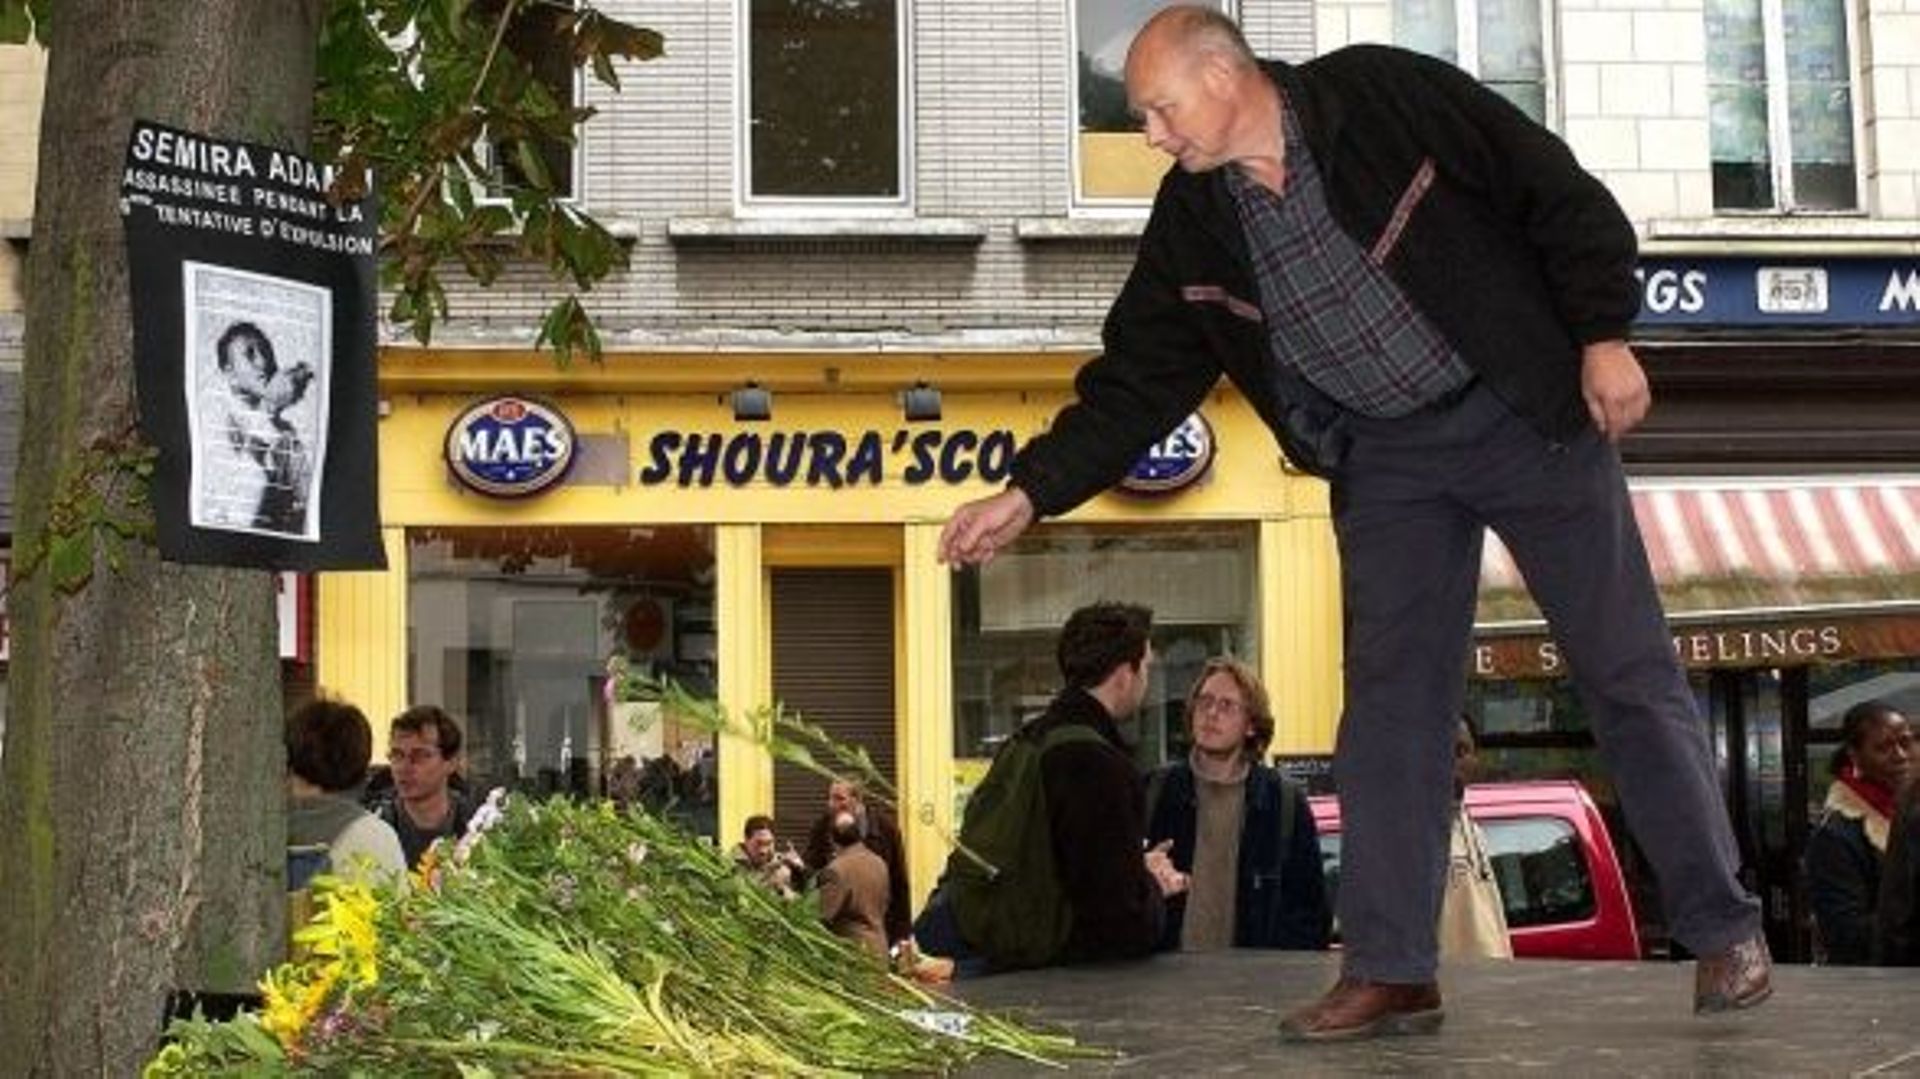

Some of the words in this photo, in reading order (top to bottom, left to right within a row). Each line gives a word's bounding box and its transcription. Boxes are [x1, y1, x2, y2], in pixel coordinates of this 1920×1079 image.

[132, 128, 256, 177] SEMIRA
[269, 151, 373, 194] ADA
[154, 203, 254, 236] TENTATIVE
[253, 187, 327, 220] PENDANT
[335, 203, 364, 223] LA
[1635, 268, 1707, 313] GS
[456, 427, 566, 464] MAES
